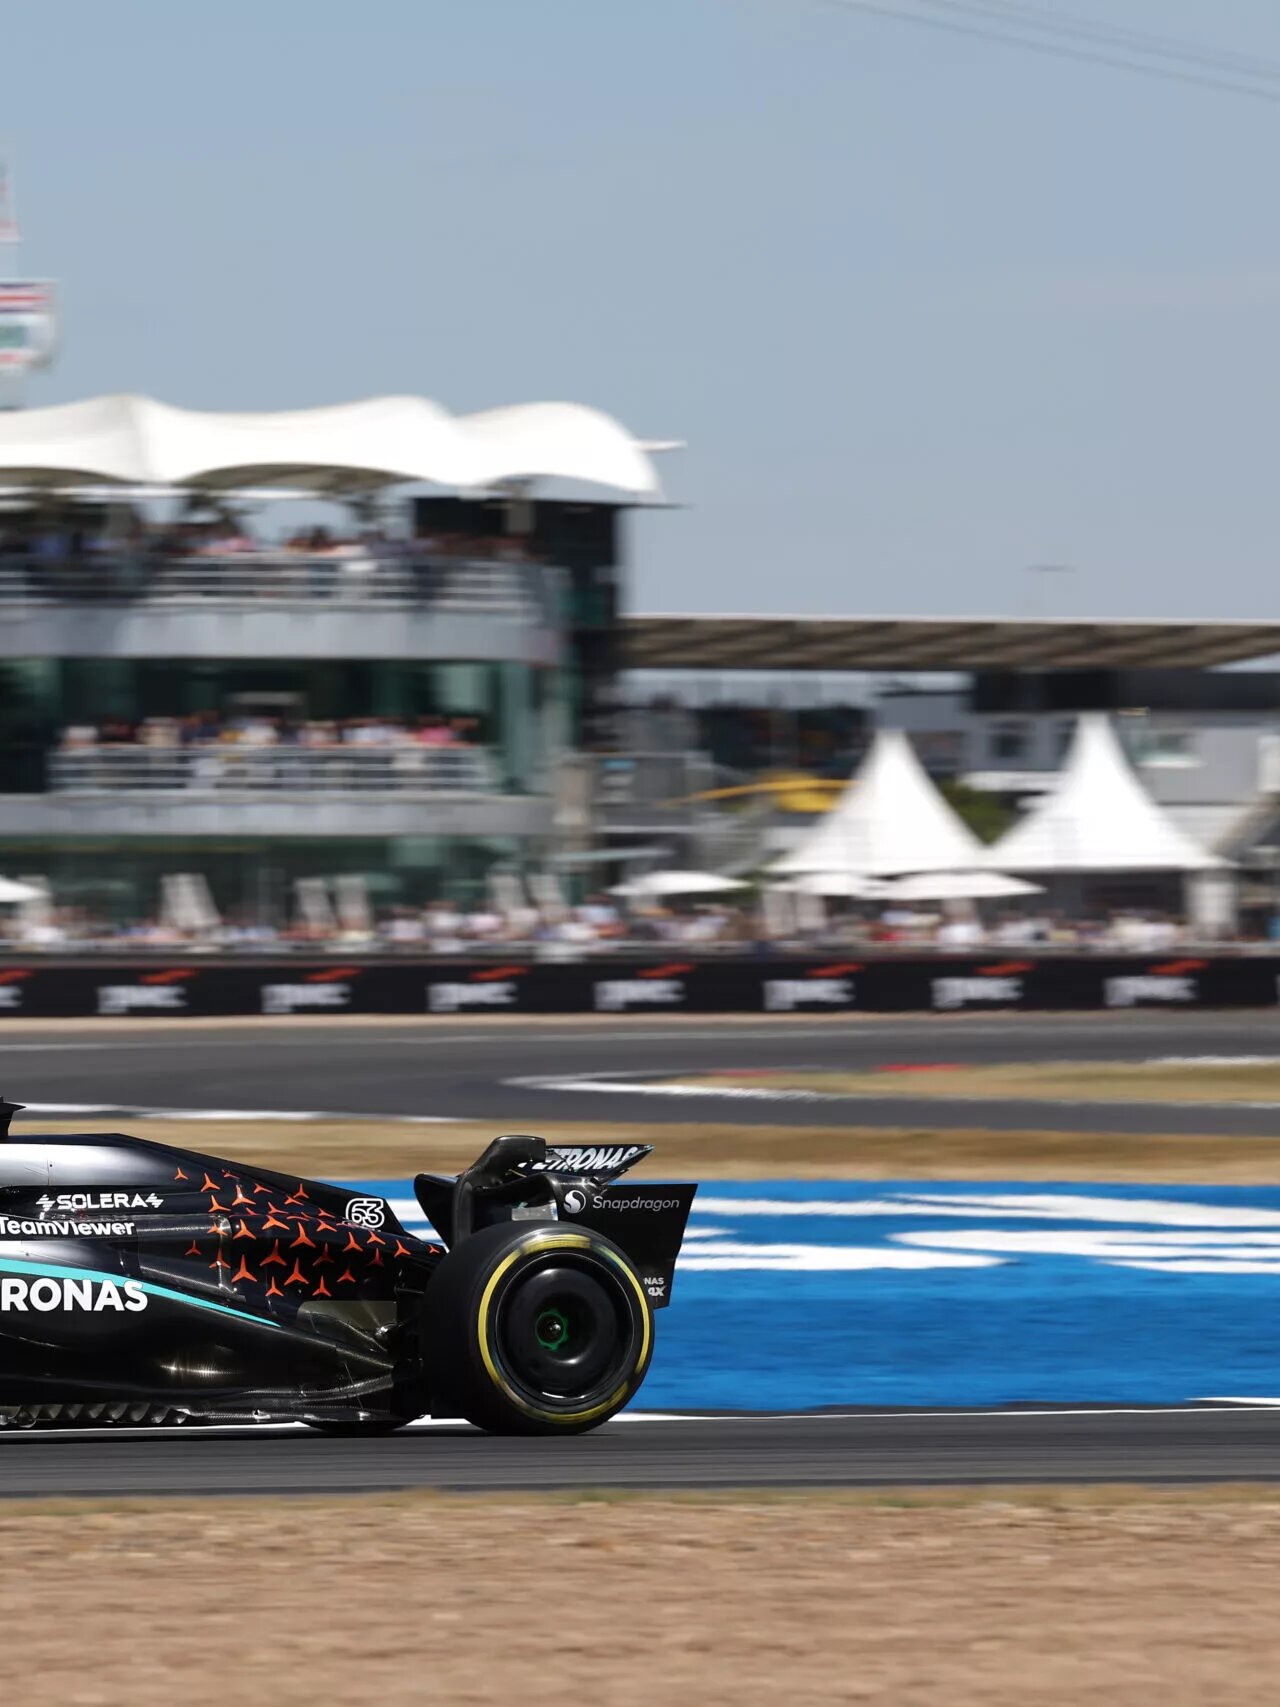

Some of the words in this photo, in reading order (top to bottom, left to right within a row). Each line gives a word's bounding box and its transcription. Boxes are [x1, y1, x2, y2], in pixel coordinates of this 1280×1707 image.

[56, 1193, 148, 1210] SOLERA
[592, 1195, 680, 1213] Snapdragon
[345, 1197, 385, 1229] 63
